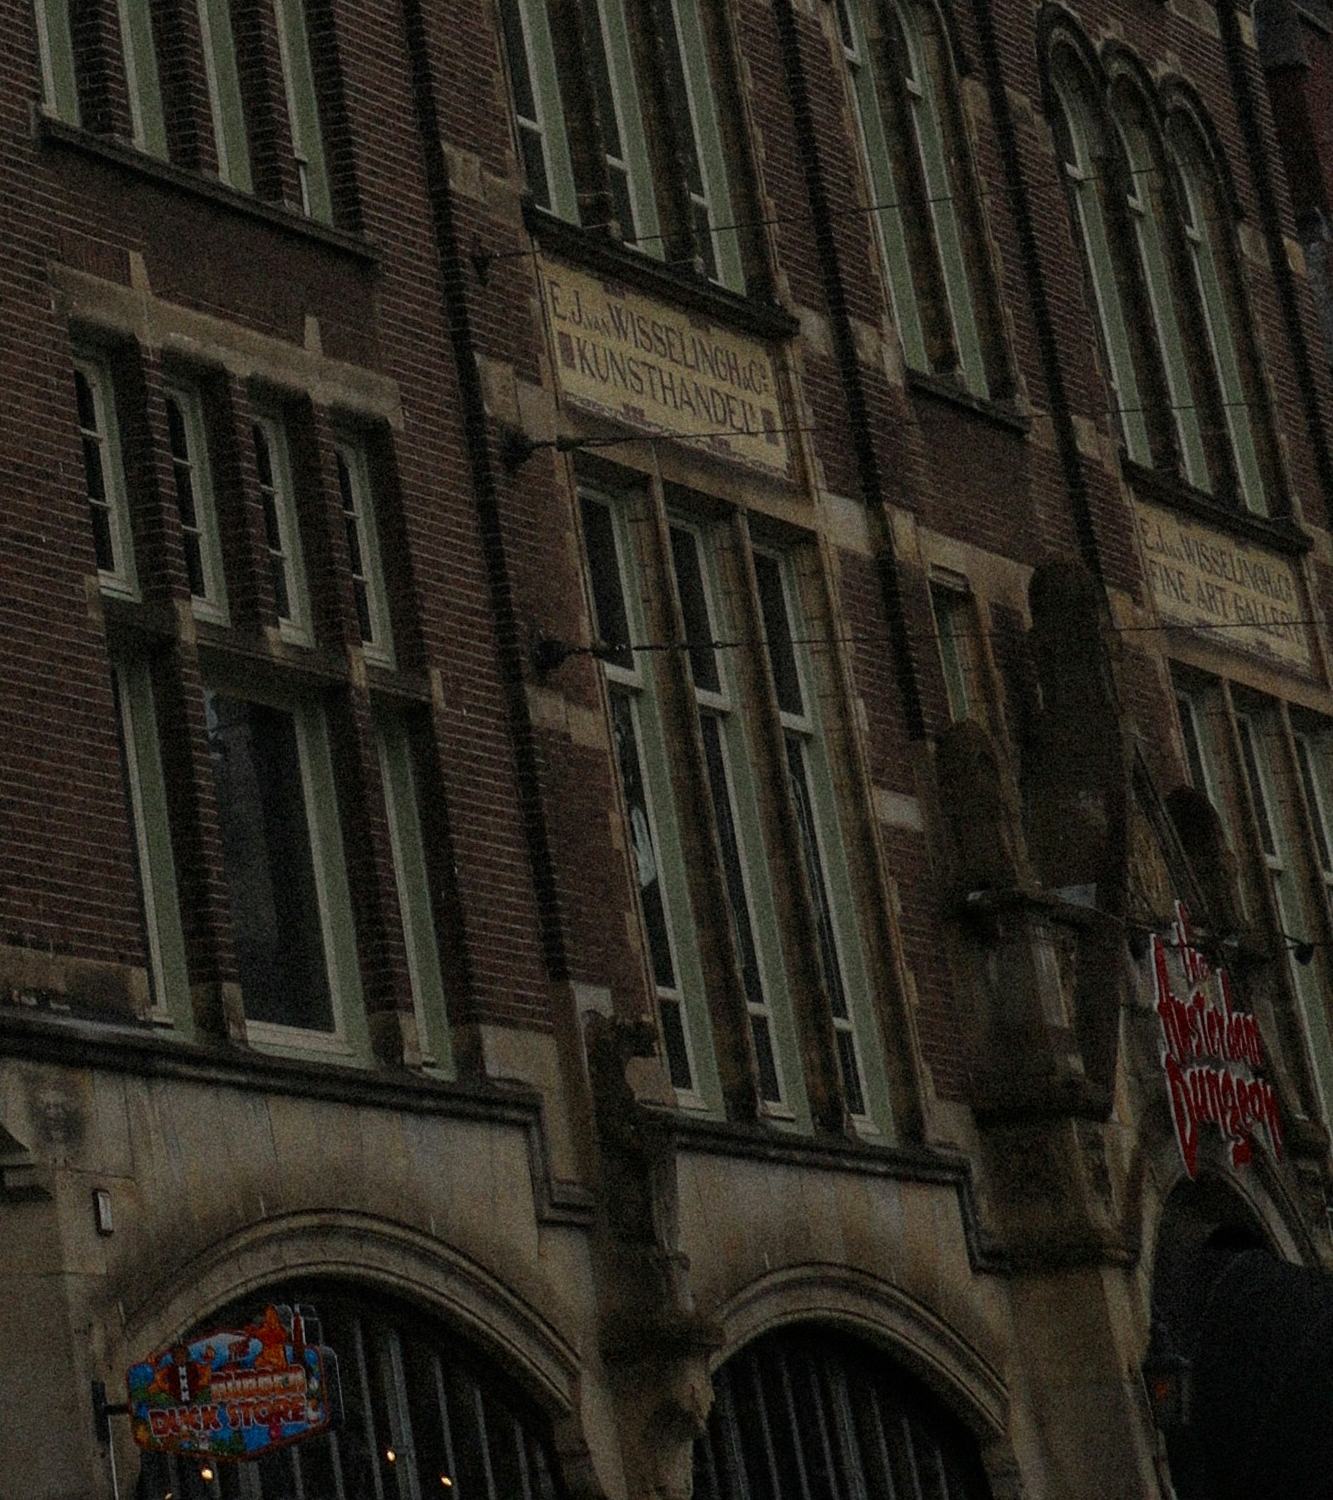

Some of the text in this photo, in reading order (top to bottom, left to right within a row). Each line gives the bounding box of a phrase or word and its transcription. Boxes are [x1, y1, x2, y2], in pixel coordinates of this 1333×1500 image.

[606, 301, 742, 385] WISSELINGH
[575, 336, 759, 437] KUNSTHANDEL
[1146, 559, 1304, 647] FINE ART GALLERY
[1179, 532, 1273, 598] WISSELINGH
[148, 1395, 306, 1437] DUCK STORE
